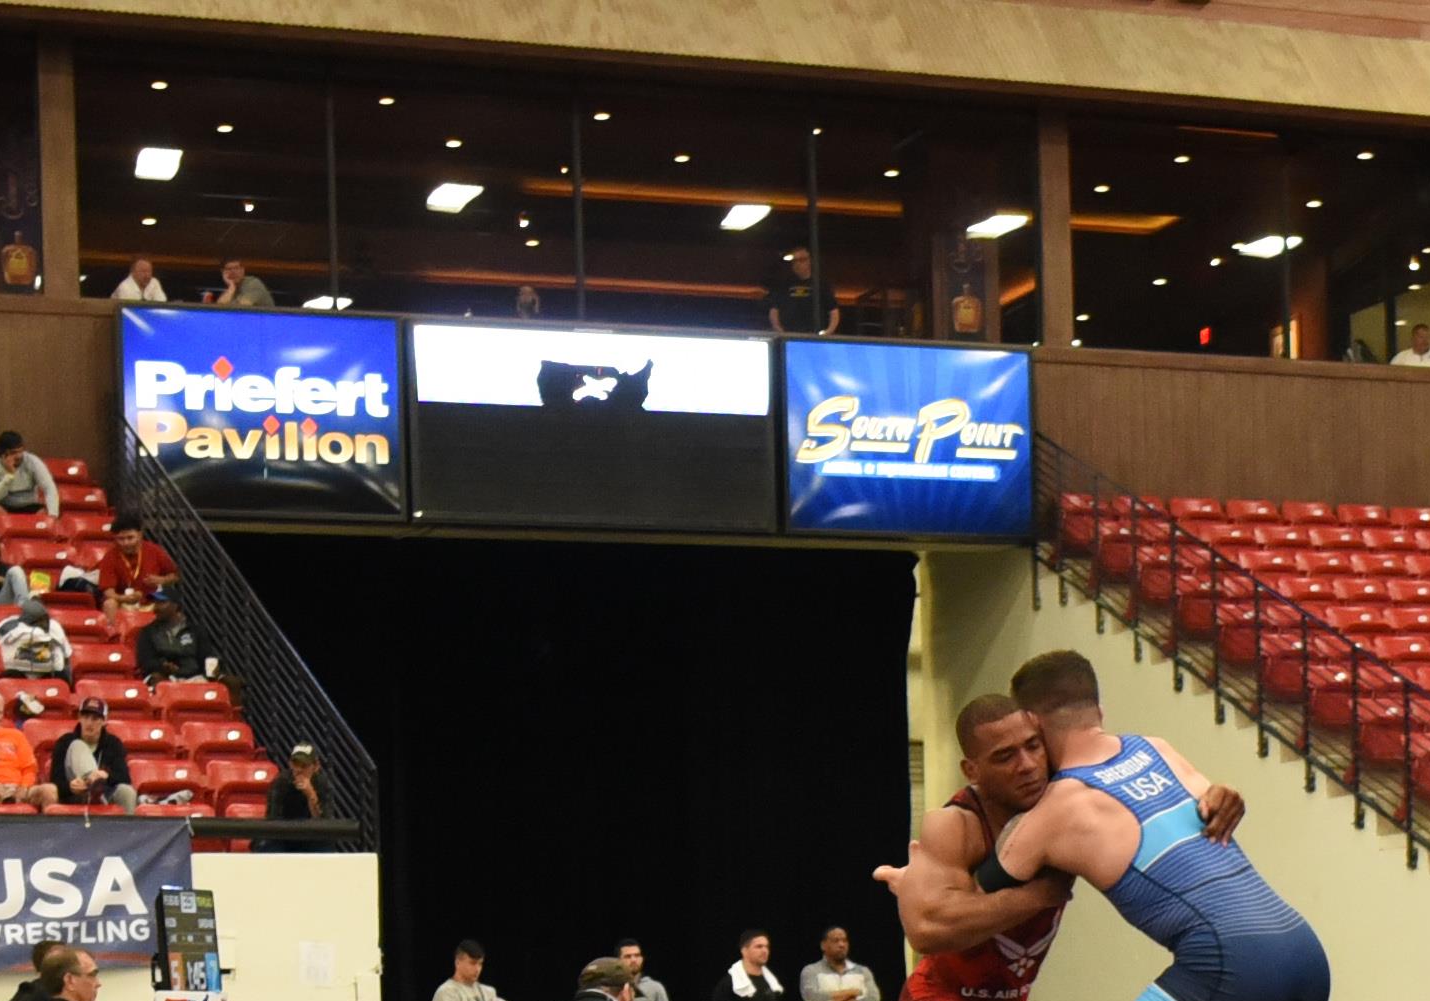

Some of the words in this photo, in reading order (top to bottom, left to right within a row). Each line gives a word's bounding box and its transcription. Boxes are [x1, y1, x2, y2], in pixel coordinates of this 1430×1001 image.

[135, 356, 390, 418] Priefert
[137, 411, 390, 465] Pavilion
[1120, 771, 1173, 801] USA
[960, 986, 992, 1000] U.S.
